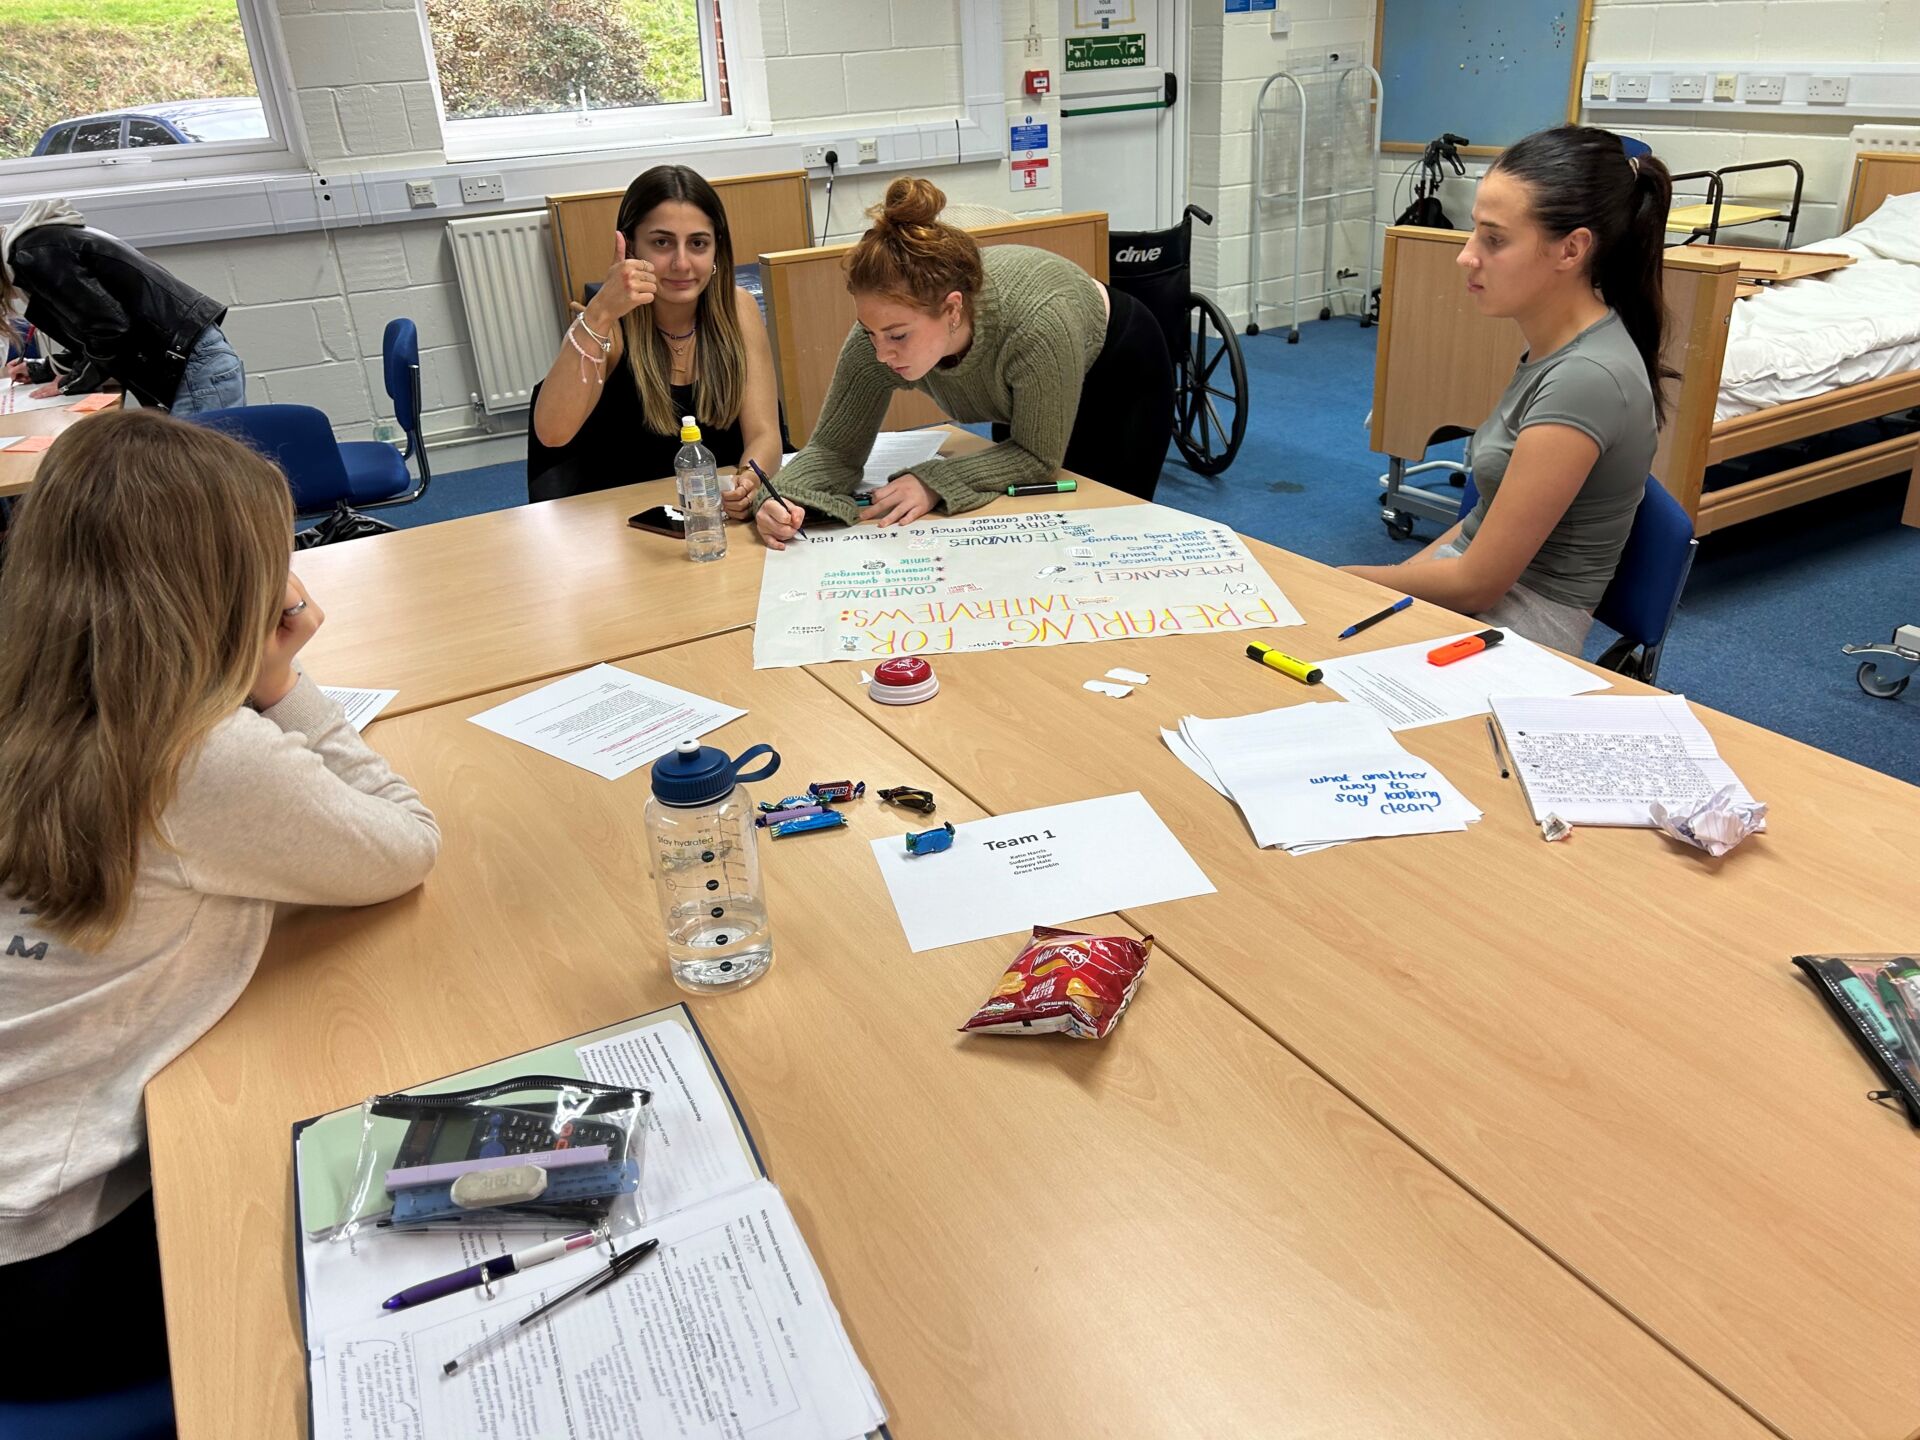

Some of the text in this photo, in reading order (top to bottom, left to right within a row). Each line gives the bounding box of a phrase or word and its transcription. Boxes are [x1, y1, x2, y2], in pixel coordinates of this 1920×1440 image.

[1068, 56, 1144, 69] Push bar to open
[1115, 246, 1162, 262] drive
[969, 513, 1050, 525] eye contact
[1016, 520, 1057, 530] STAR
[931, 524, 1007, 535] competency
[842, 533, 887, 543] active
[1081, 530, 1205, 544] open body language
[1154, 534, 1207, 543] hygienic
[1175, 541, 1211, 549] smart
[1110, 548, 1215, 559] natural beauty
[900, 557, 931, 565] smile
[1119, 557, 1173, 565] business
[1095, 563, 1244, 584] APPEARANCE!
[820, 575, 930, 587] practice questions
[816, 585, 936, 601] CONFIDENCE!
[841, 595, 1077, 627] INTERVIEWS:
[866, 598, 1278, 656] PREPARING FOR
[1310, 770, 1427, 784] what another
[1340, 781, 1408, 794] way to
[1335, 789, 1441, 807] say looking
[1380, 803, 1434, 814] clean
[674, 836, 714, 847] hydrated
[983, 829, 1056, 851] Team 1
[1010, 852, 1027, 860] Katie
[6, 935, 48, 960] M
[1033, 945, 1087, 966] WALKERS
[1031, 976, 1058, 995] READY
[1025, 985, 1055, 1002] SALTED
[688, 1099, 703, 1122] Scholarship
[744, 1214, 756, 1234] Interview
[751, 1233, 760, 1246] Skills
[759, 1209, 803, 1306] NHS Vocational Scholarship Answer Sheet
[736, 1261, 745, 1273] about
[740, 1272, 752, 1290] yourself
[546, 1332, 557, 1346] about
[551, 1353, 562, 1367] NHS?
[694, 1372, 705, 1390] applied
